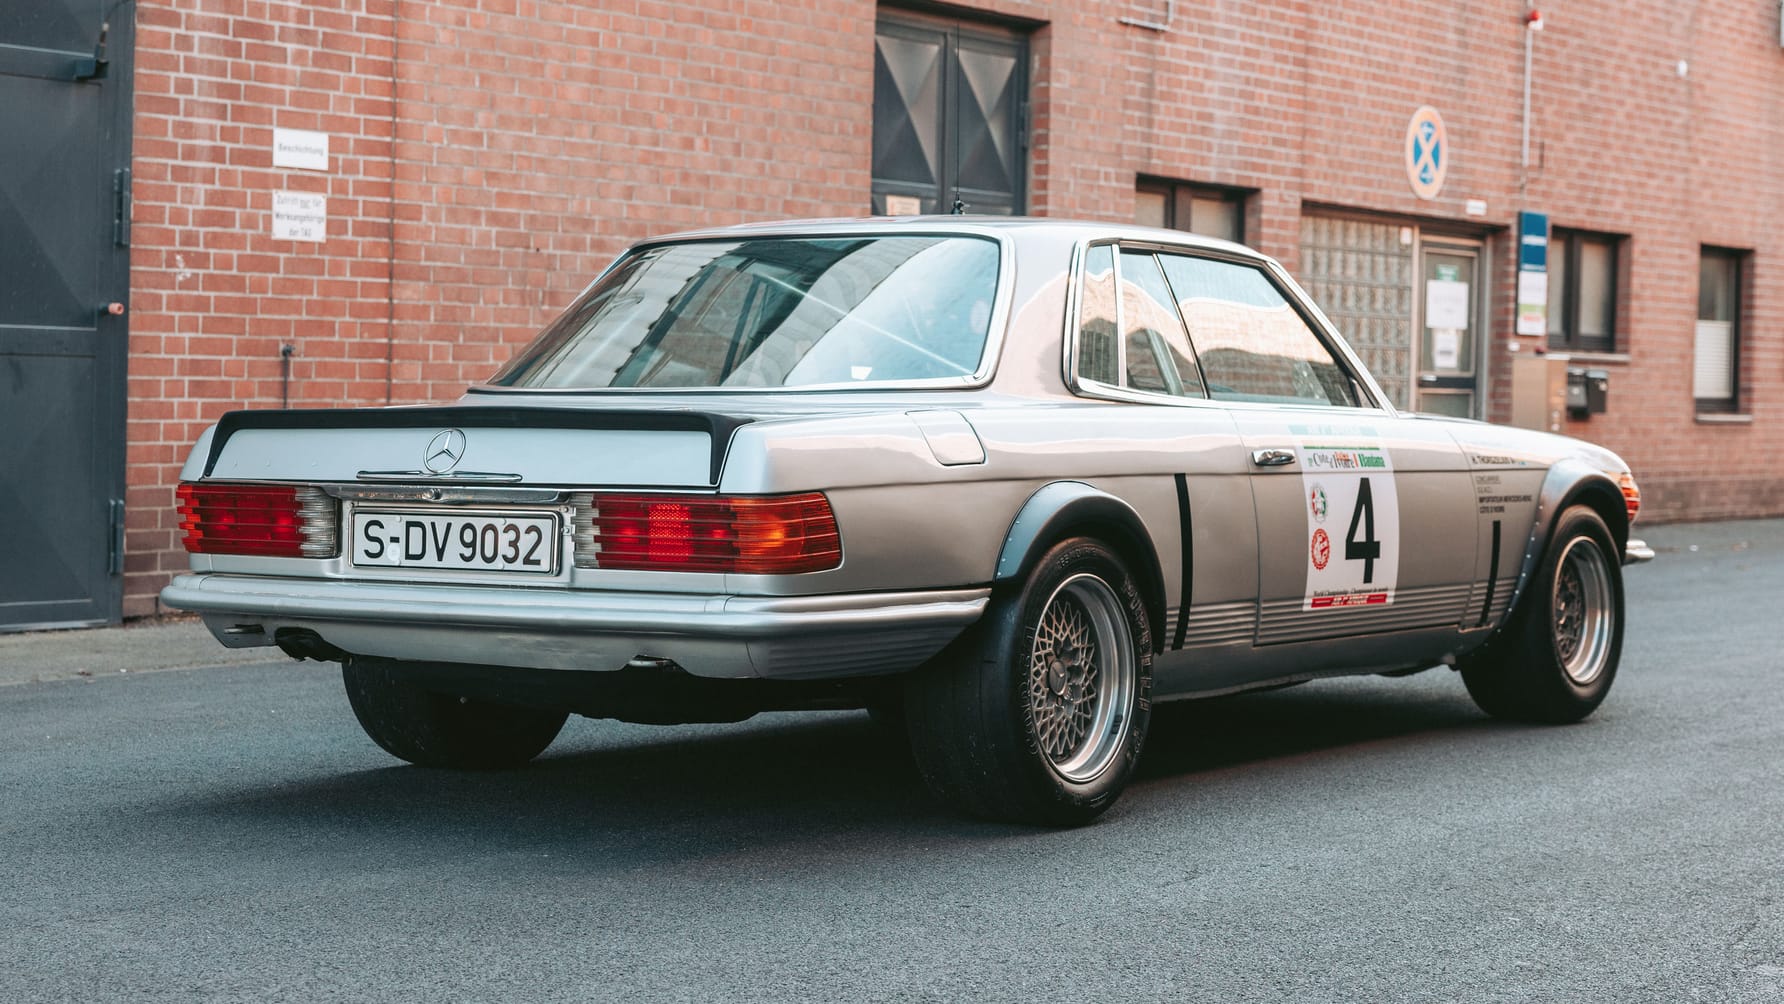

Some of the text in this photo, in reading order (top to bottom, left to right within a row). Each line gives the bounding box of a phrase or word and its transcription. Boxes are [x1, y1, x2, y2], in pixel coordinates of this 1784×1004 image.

[364, 519, 543, 566] S-DV 9032
[1345, 477, 1381, 584] 4
